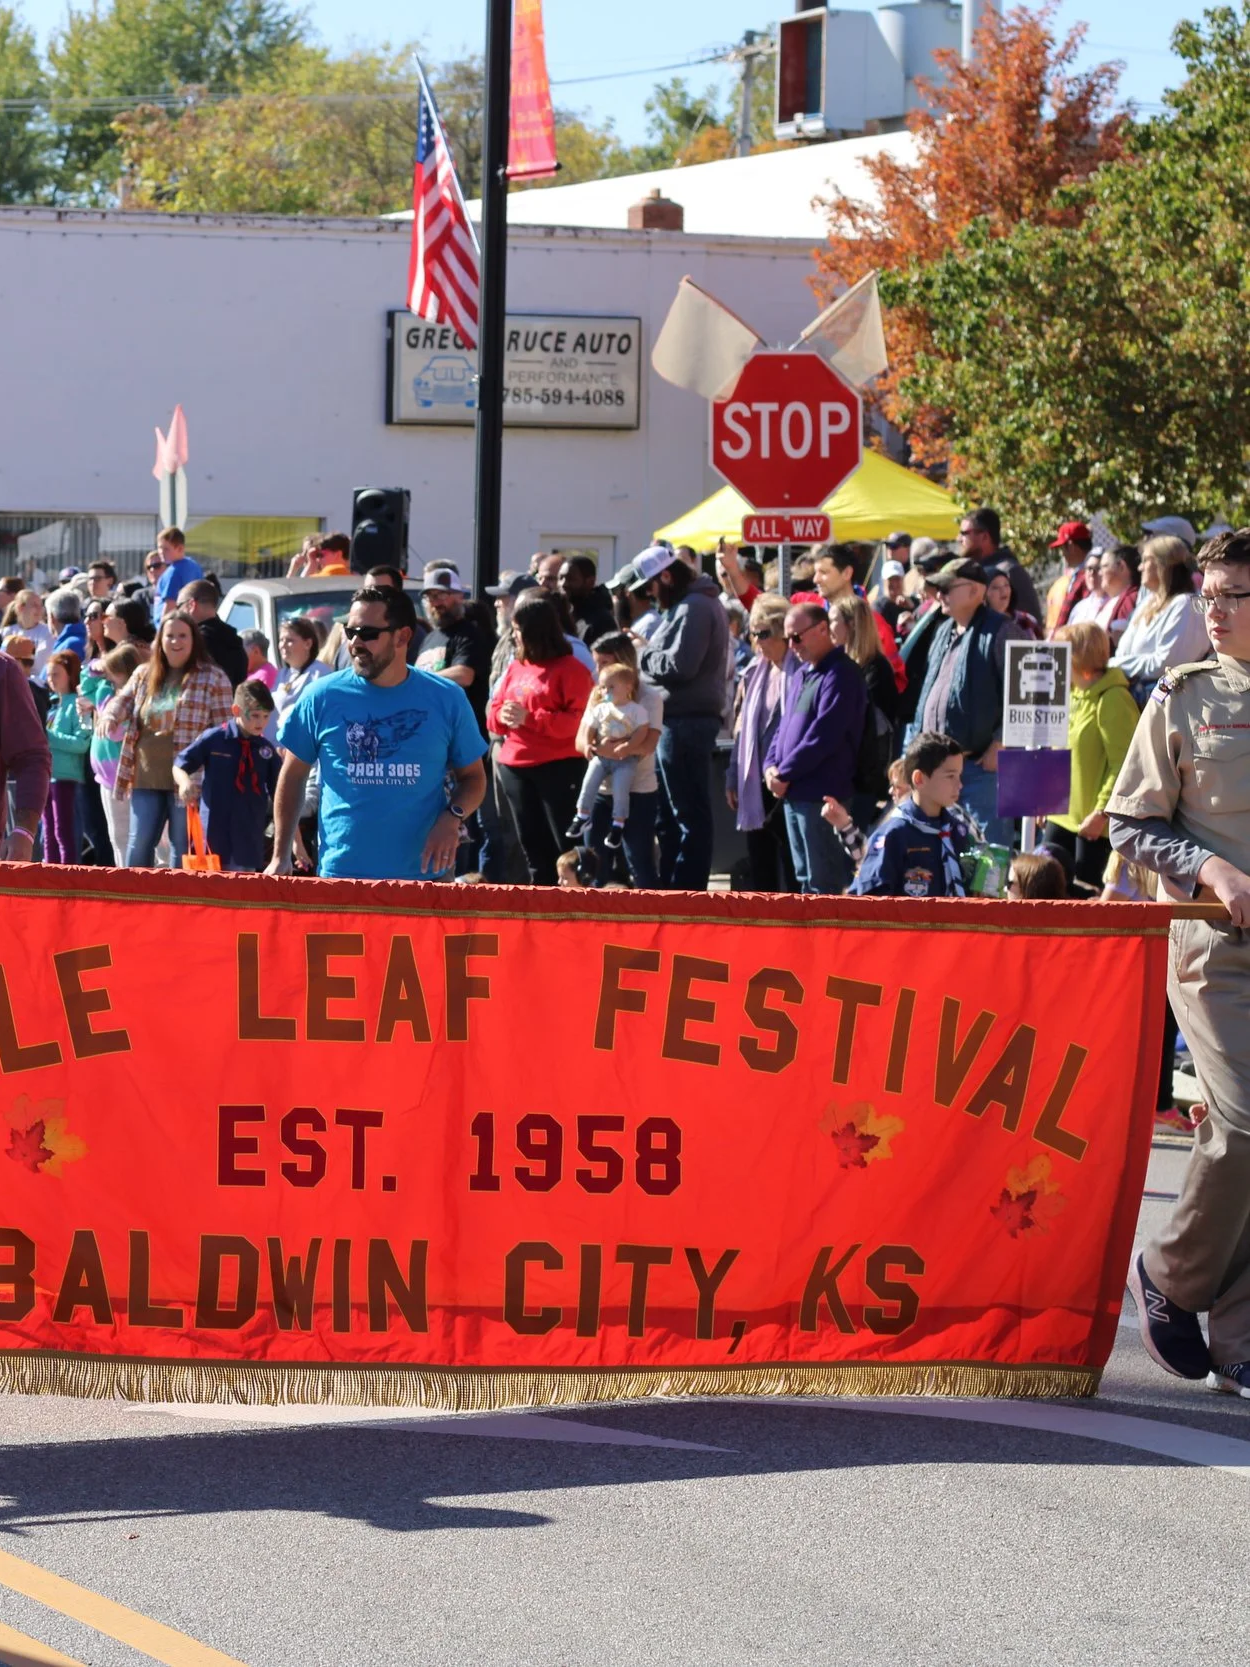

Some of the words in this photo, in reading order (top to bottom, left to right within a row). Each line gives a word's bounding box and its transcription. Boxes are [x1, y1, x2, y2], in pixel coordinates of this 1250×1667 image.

[507, 329, 566, 353] RUCE
[573, 332, 632, 355] AUTO
[550, 357, 578, 369] AND
[508, 370, 618, 386] PERFORMANCE
[721, 401, 851, 459] STOP
[749, 519, 781, 538] ALL
[792, 518, 824, 537] WAY
[1009, 708, 1033, 724] BUS
[1034, 708, 1066, 724] STOP
[347, 763, 384, 777] PACK
[388, 763, 421, 777] 3065
[351, 777, 384, 785] BALDWIN
[237, 932, 499, 1043] LEAF
[593, 943, 1089, 1163] FESTIVAL
[217, 1104, 397, 1192] EST.
[469, 1111, 682, 1196] 1958
[503, 1240, 747, 1355] CITY,
[799, 1241, 926, 1337] KS
